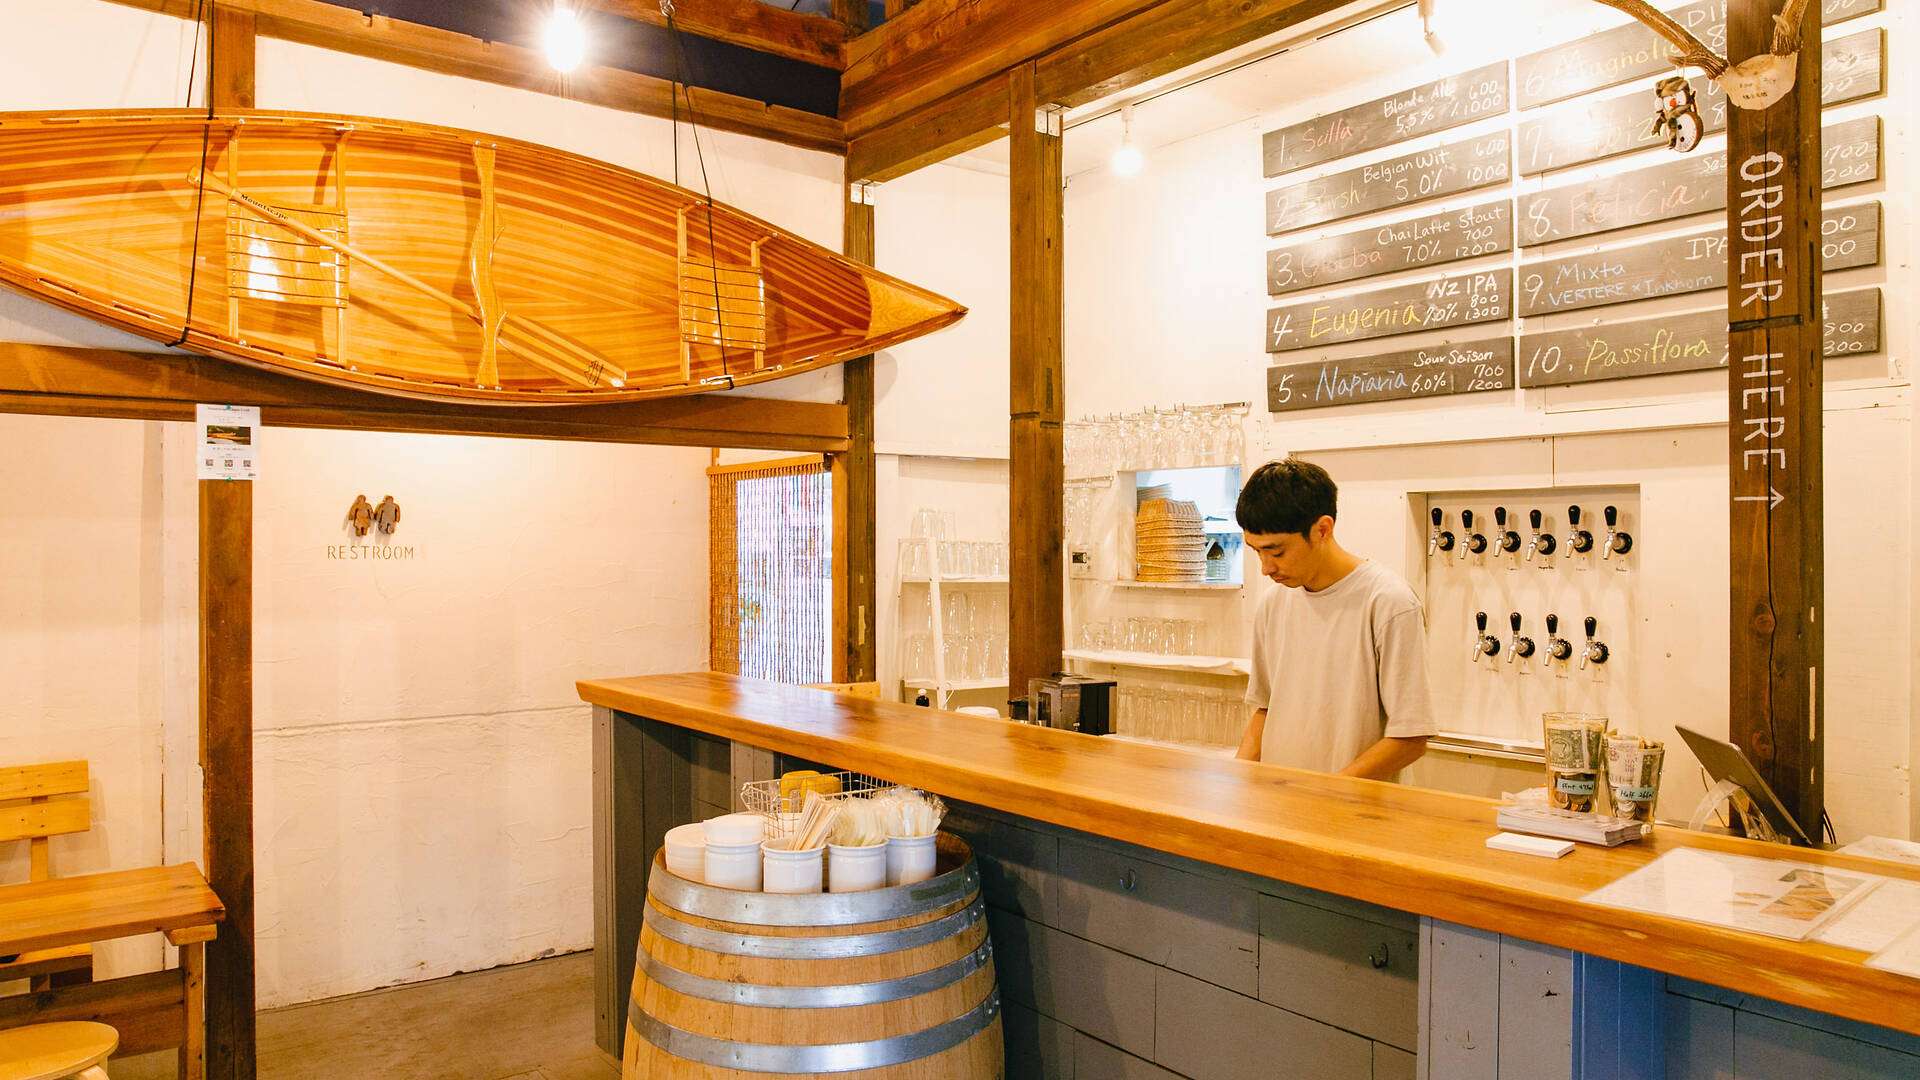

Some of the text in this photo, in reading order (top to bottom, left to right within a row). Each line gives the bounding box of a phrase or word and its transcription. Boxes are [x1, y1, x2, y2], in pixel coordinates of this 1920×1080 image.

[1469, 80, 1498, 100] 600
[1384, 90, 1424, 118] Blonde
[1301, 118, 1353, 152] Scilla
[1476, 139, 1504, 156] 600
[1364, 149, 1450, 185] Belgian Wit
[1467, 163, 1508, 182] 1000
[1823, 162, 1870, 184] 200
[1395, 168, 1442, 201] 5.0%
[1570, 181, 1697, 233] Felicia
[1378, 205, 1504, 245] Chai Latte Stout
[1463, 225, 1493, 241] 700
[1740, 151, 1784, 308] ORDER
[1821, 216, 1856, 235] 00
[1402, 240, 1442, 263] 7.0%
[1455, 241, 1498, 257] 1200
[1822, 240, 1856, 258] 00
[1276, 252, 1298, 286] 3.
[1428, 273, 1497, 299] NZ IPA
[1523, 262, 1626, 309] 9. Mixta
[1549, 281, 1625, 306] VERTERE
[1470, 294, 1499, 309] 800
[1273, 301, 1421, 346] 4. Eugenia
[1413, 351, 1447, 367] Sour
[1584, 328, 1712, 376] Passiflora
[1823, 341, 1863, 355] 300
[1411, 371, 1447, 393] 6.0%
[1474, 364, 1505, 378] 700
[1277, 373, 1307, 404] 5.
[1467, 379, 1504, 392] 1200
[1742, 352, 1786, 471] HERE
[327, 545, 415, 561] RESTROOM
